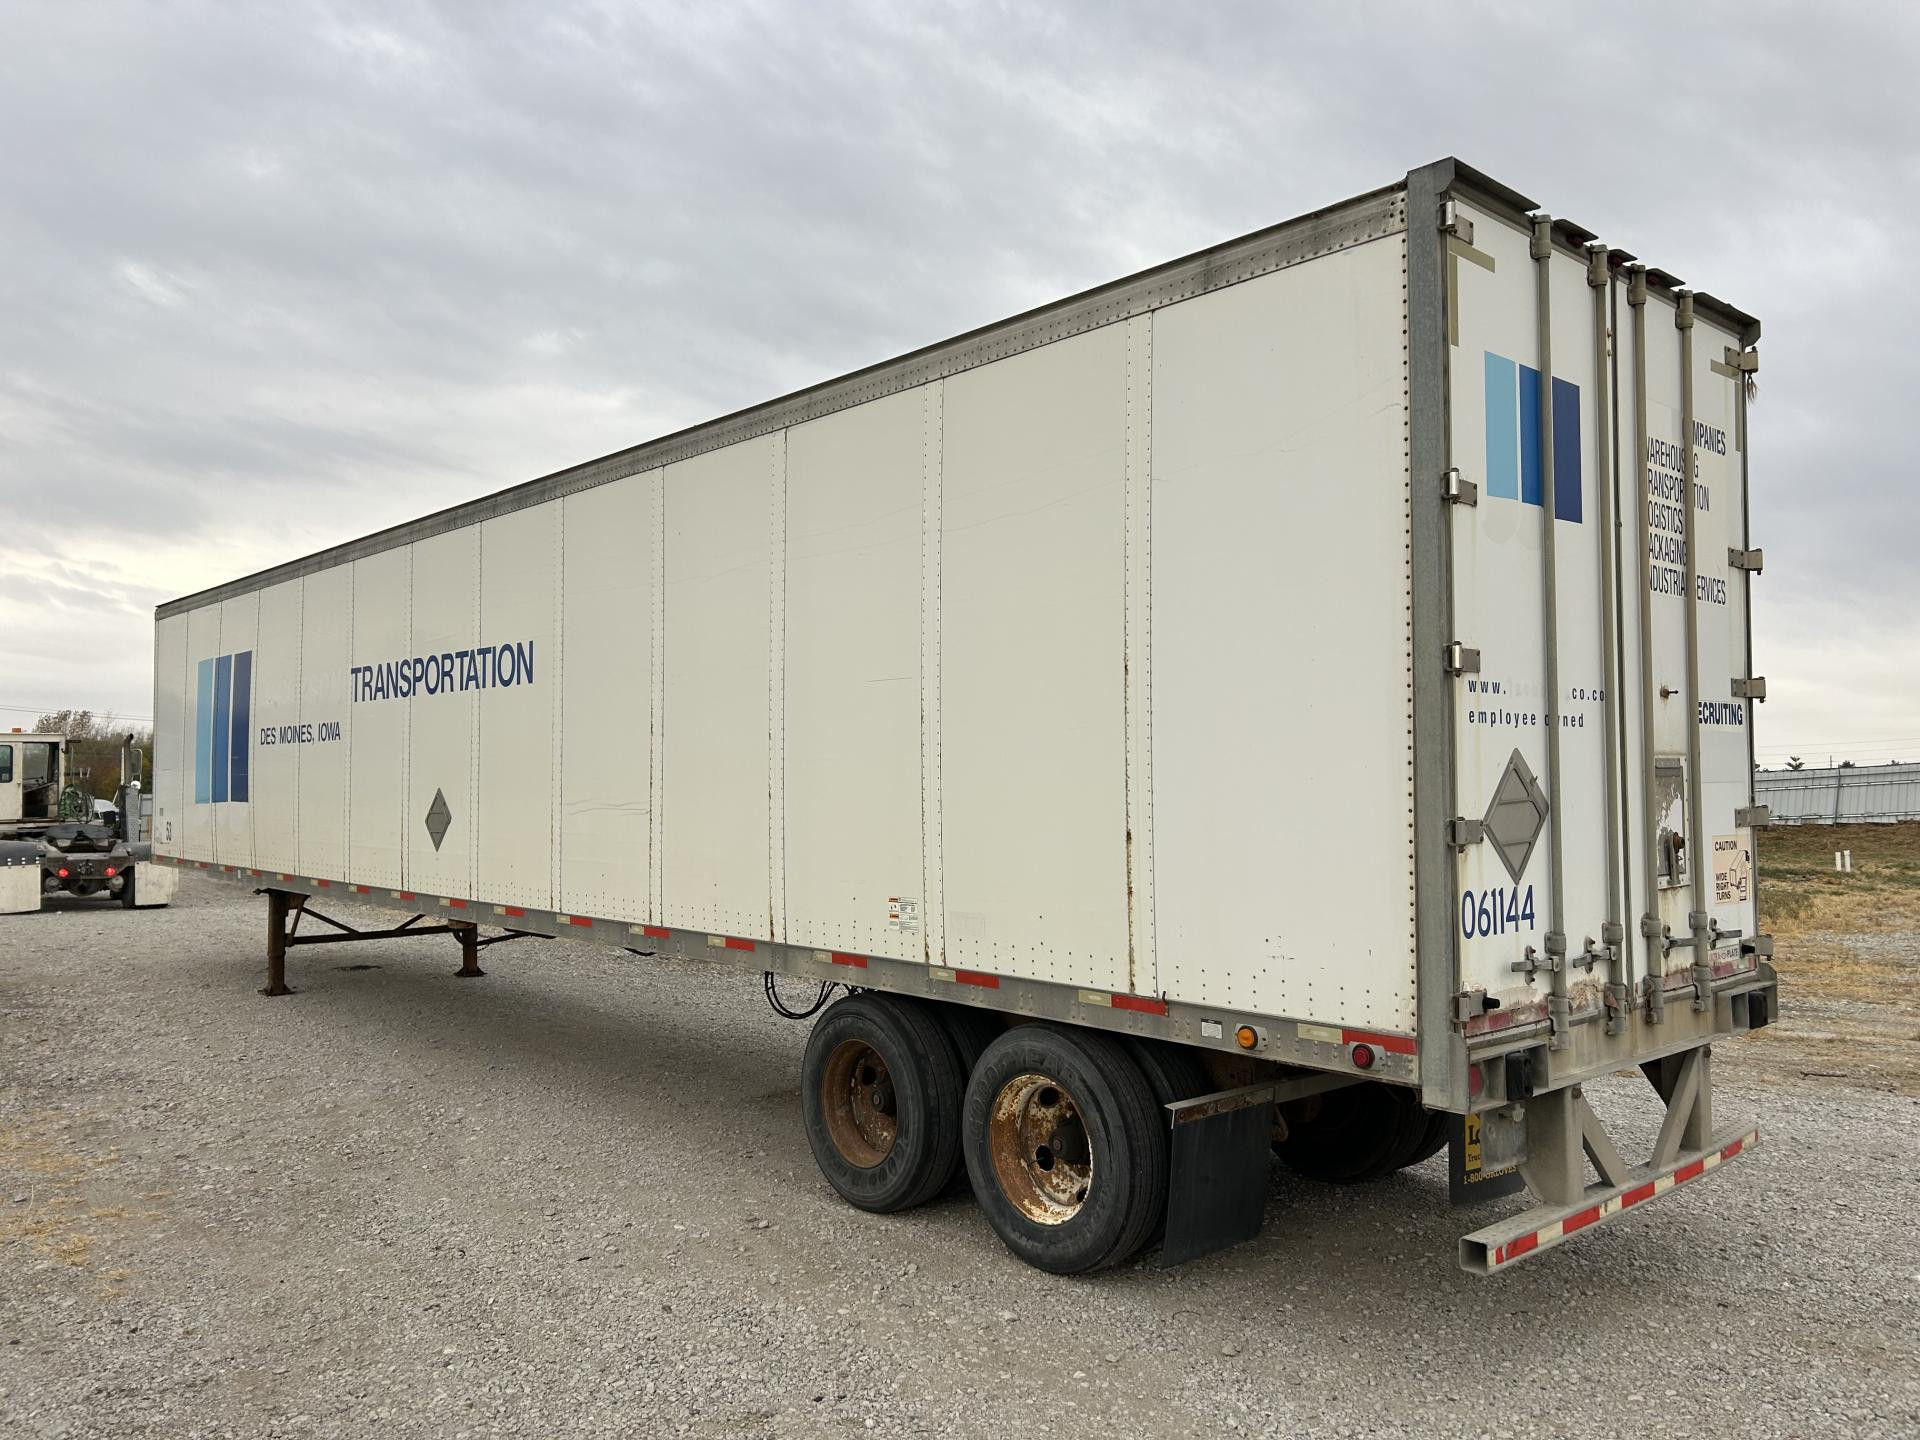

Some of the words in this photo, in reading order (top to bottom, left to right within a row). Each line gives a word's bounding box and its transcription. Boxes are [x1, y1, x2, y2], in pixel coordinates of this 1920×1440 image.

[1692, 420, 1726, 456] MPANIES
[1648, 500, 1683, 535] OGISTICS
[1648, 532, 1687, 567] ACKAGING
[1696, 574, 1726, 606] ERVICES
[350, 640, 534, 703] TRANSPORTATION
[1468, 708, 1537, 729] employee
[1544, 712, 1585, 728] oned
[1698, 701, 1743, 726] ECRUITING
[260, 727, 277, 746] DES
[279, 723, 315, 746] MOINES,
[317, 721, 341, 742] IOWA
[1714, 840, 1738, 852] CAUTION
[1715, 872, 1728, 881] WIDE
[1715, 881, 1730, 892] RIGHT
[1716, 891, 1732, 902] TURNS
[1461, 884, 1535, 940] 061144
